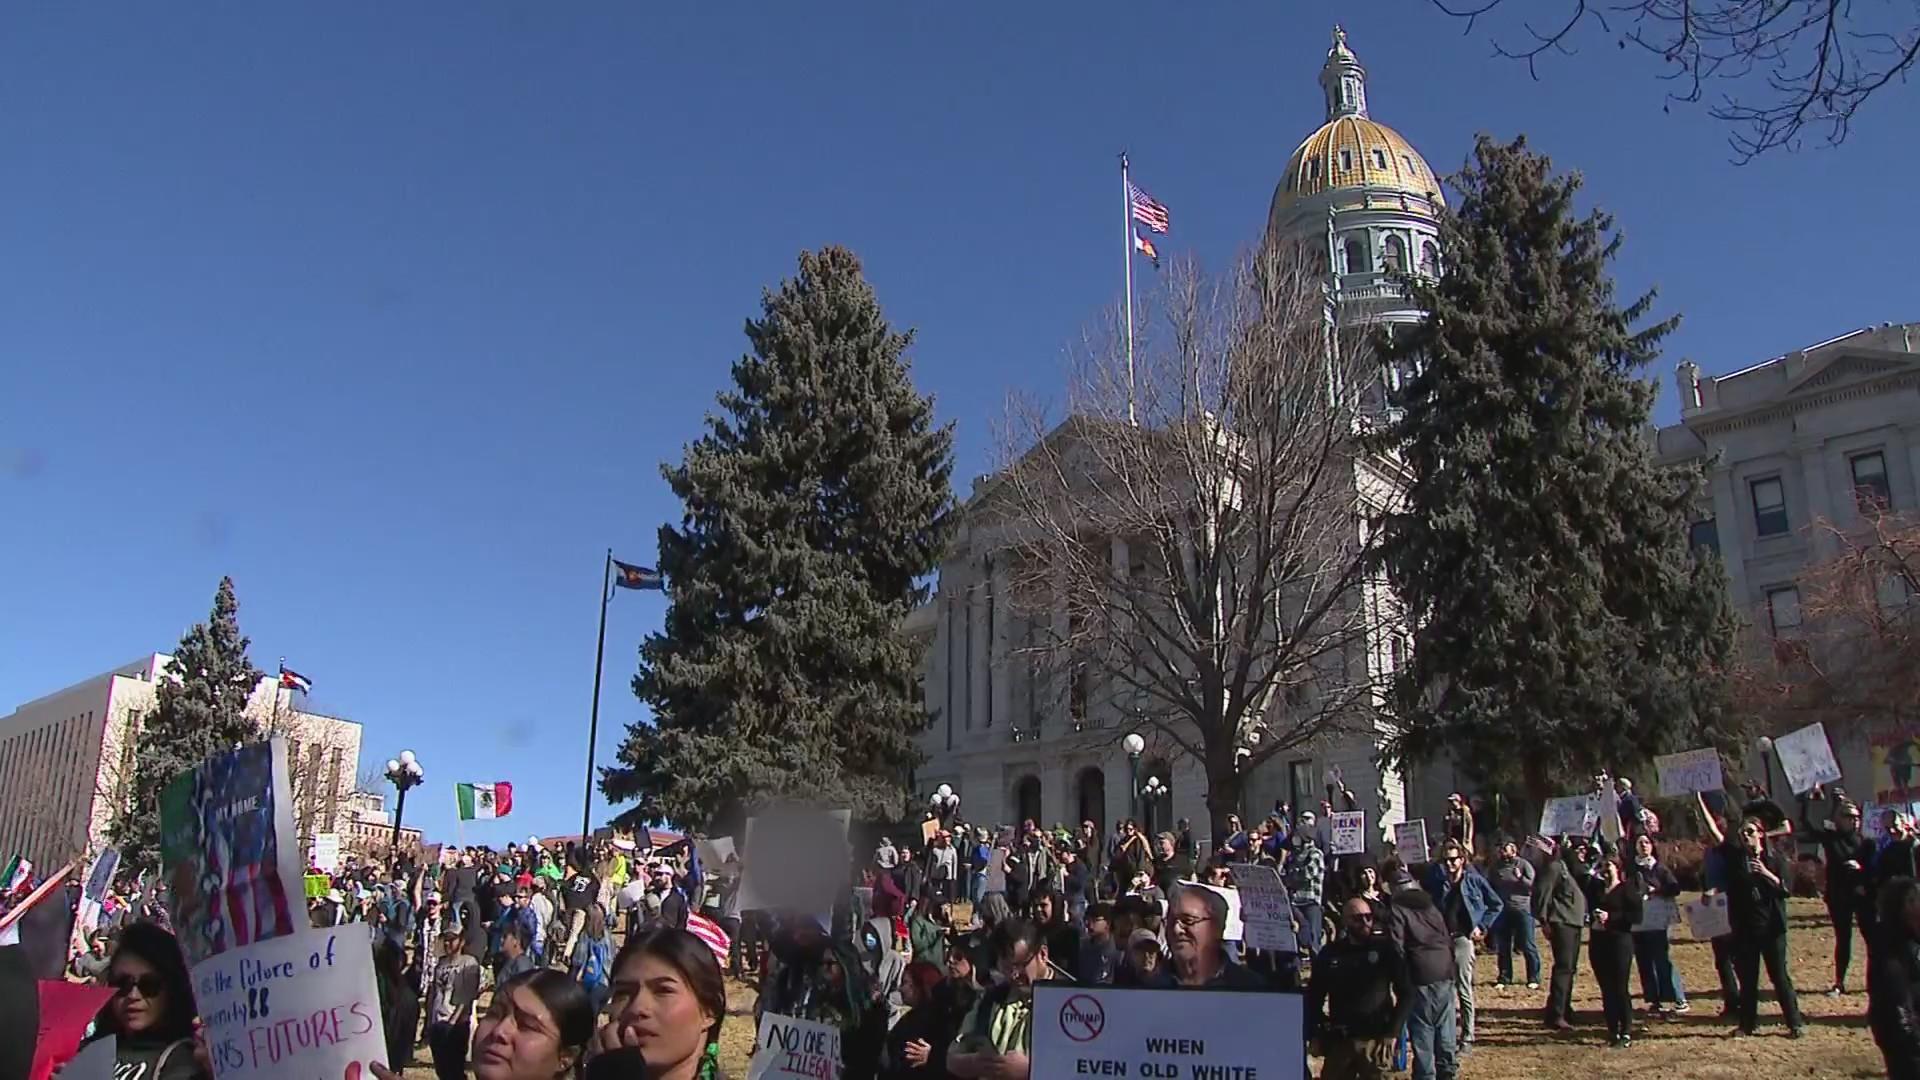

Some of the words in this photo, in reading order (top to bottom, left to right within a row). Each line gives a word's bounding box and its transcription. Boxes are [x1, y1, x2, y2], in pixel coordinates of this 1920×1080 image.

[239, 957, 294, 990] future
[309, 935, 336, 969] of
[1064, 1011, 1100, 1024] TRUMP
[248, 1001, 373, 1069] FUTURES
[766, 1023, 800, 1052] NO
[1145, 1037, 1204, 1055] WHEN
[1076, 1058, 1127, 1077] EVEN
[1139, 1062, 1179, 1079] OLD
[1192, 1064, 1257, 1080] WHITE
